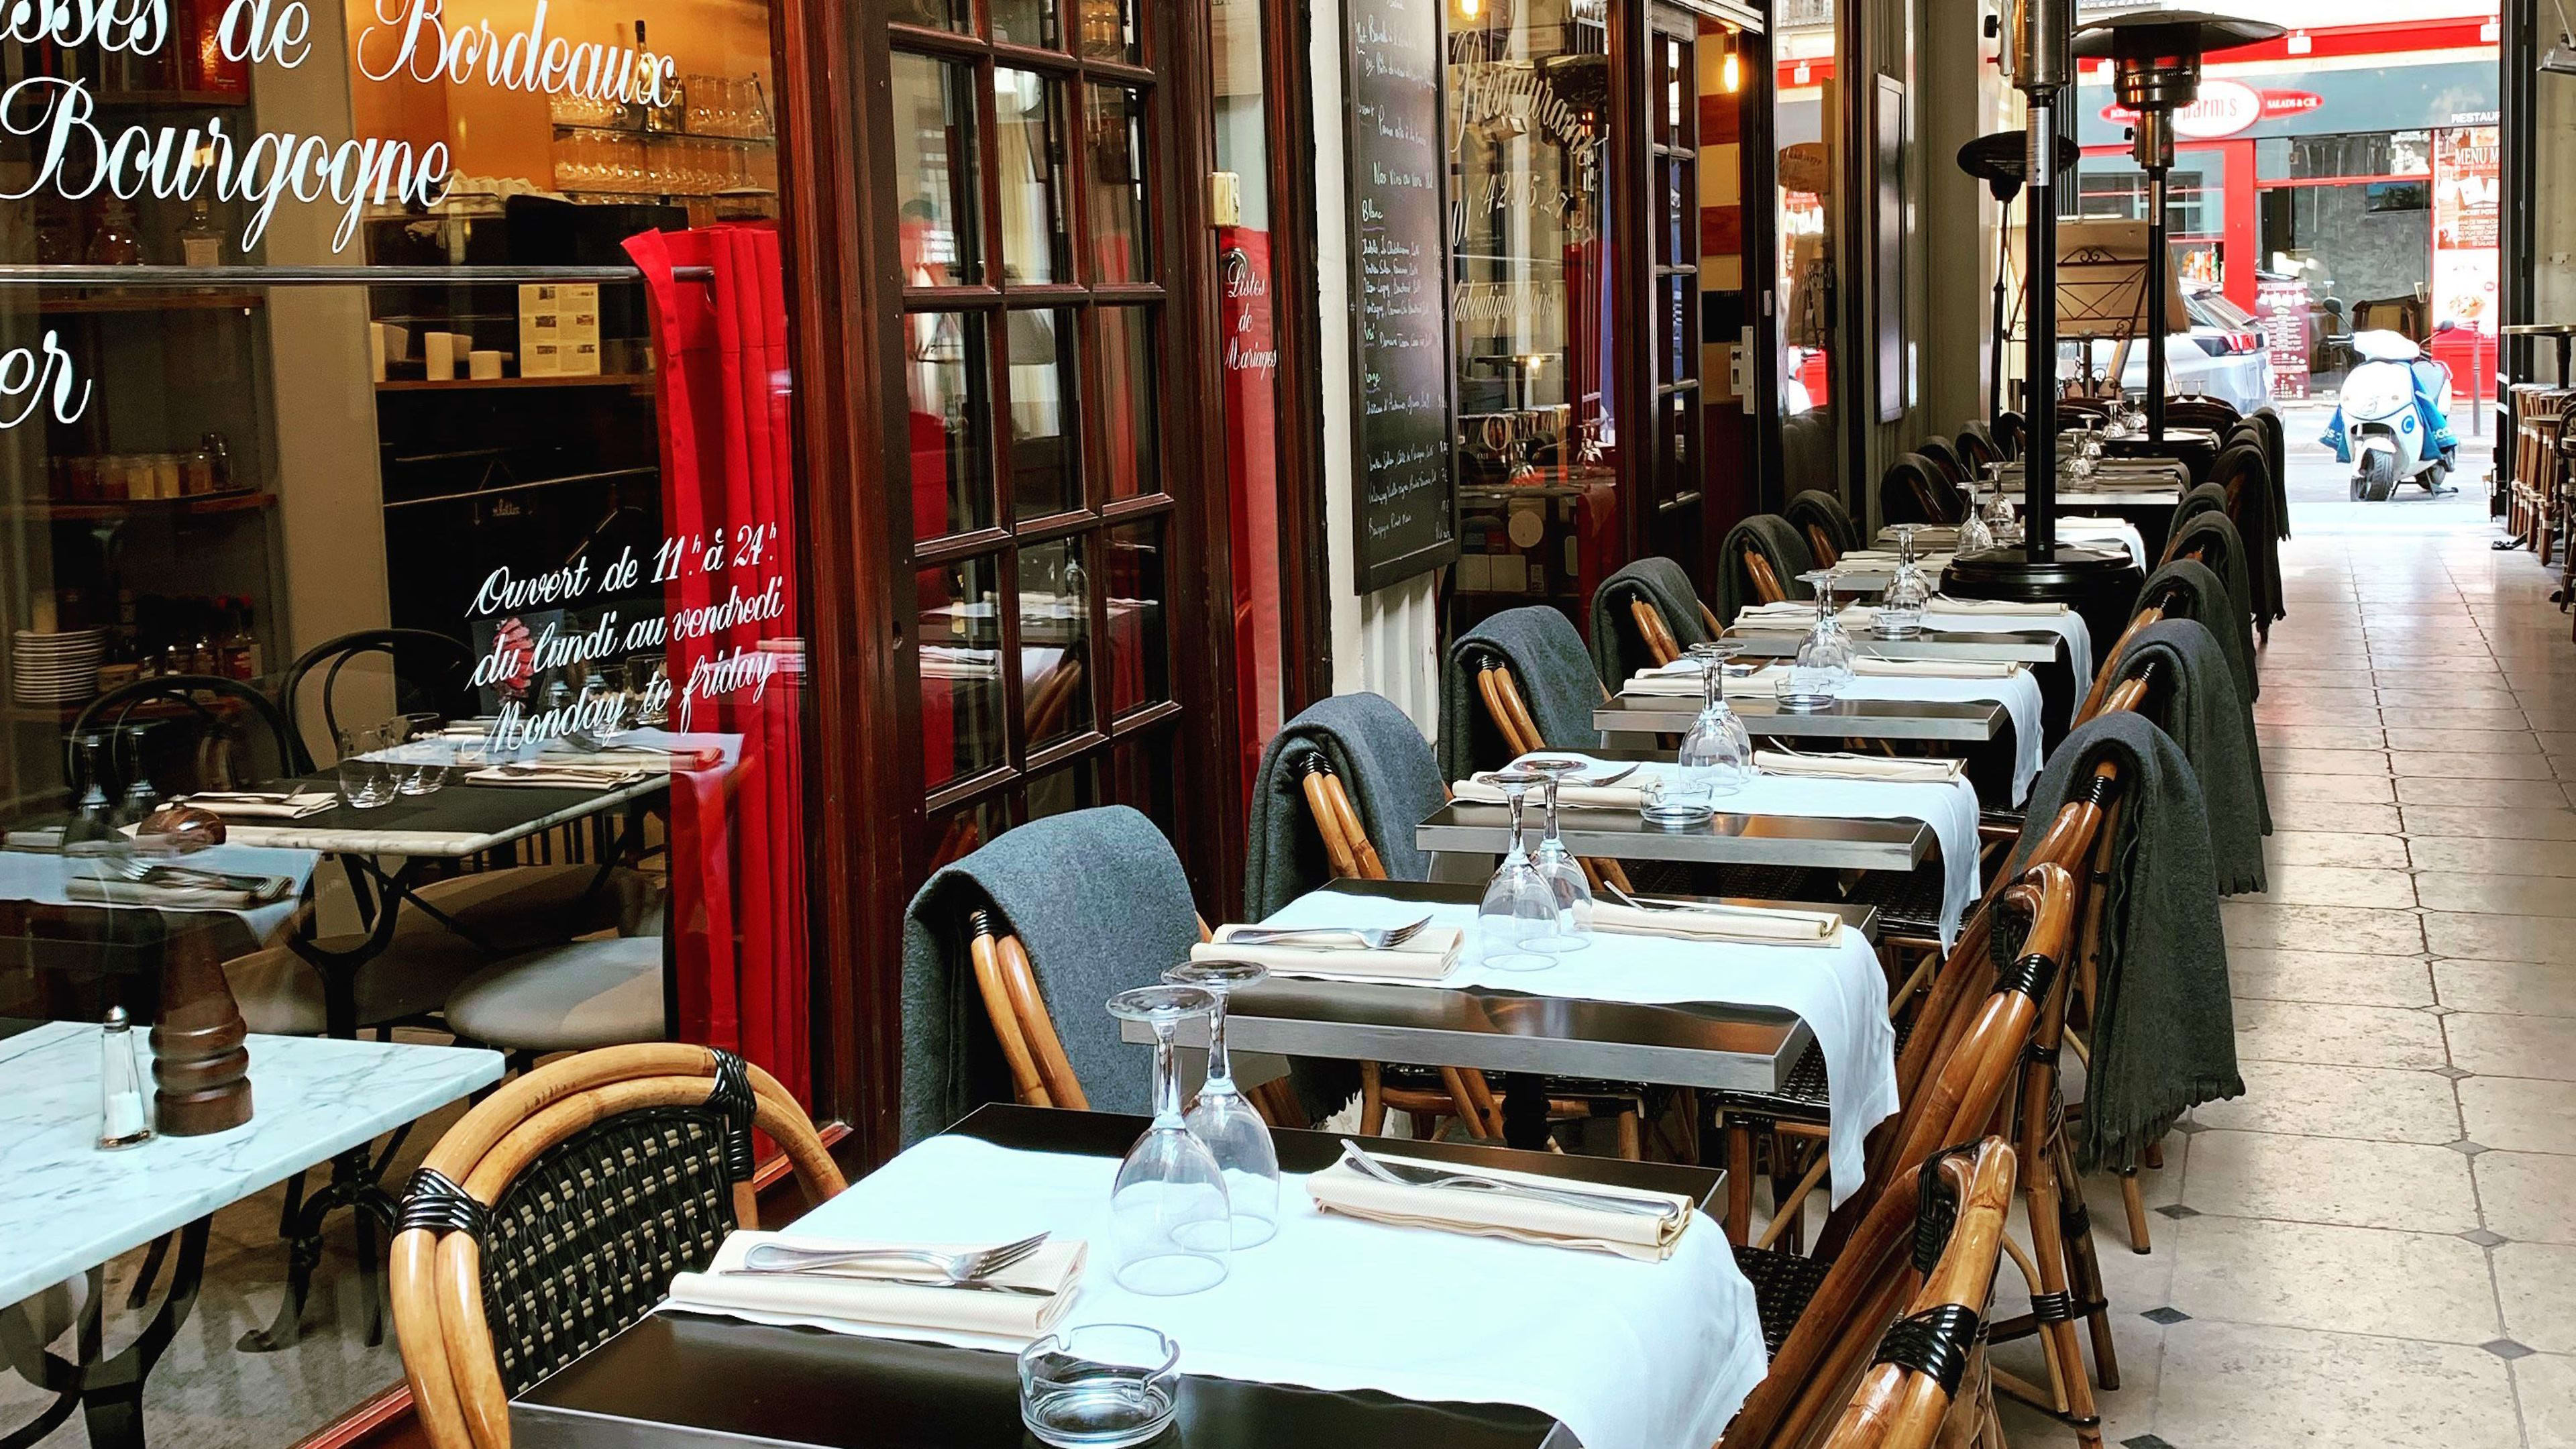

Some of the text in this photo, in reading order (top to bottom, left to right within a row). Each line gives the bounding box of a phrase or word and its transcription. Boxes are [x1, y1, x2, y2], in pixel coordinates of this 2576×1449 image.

[203, 0, 311, 68] de
[358, 0, 682, 108] Bordeaux
[0, 76, 451, 254] Bourgogne
[1228, 261, 1266, 298] Listes
[1235, 303, 1253, 333] de
[1224, 337, 1277, 380] Mariages
[465, 556, 590, 617] Ouvert
[598, 546, 638, 593] de
[464, 576, 785, 691] du lundi au vendredi
[461, 646, 775, 760] Monday to friday
